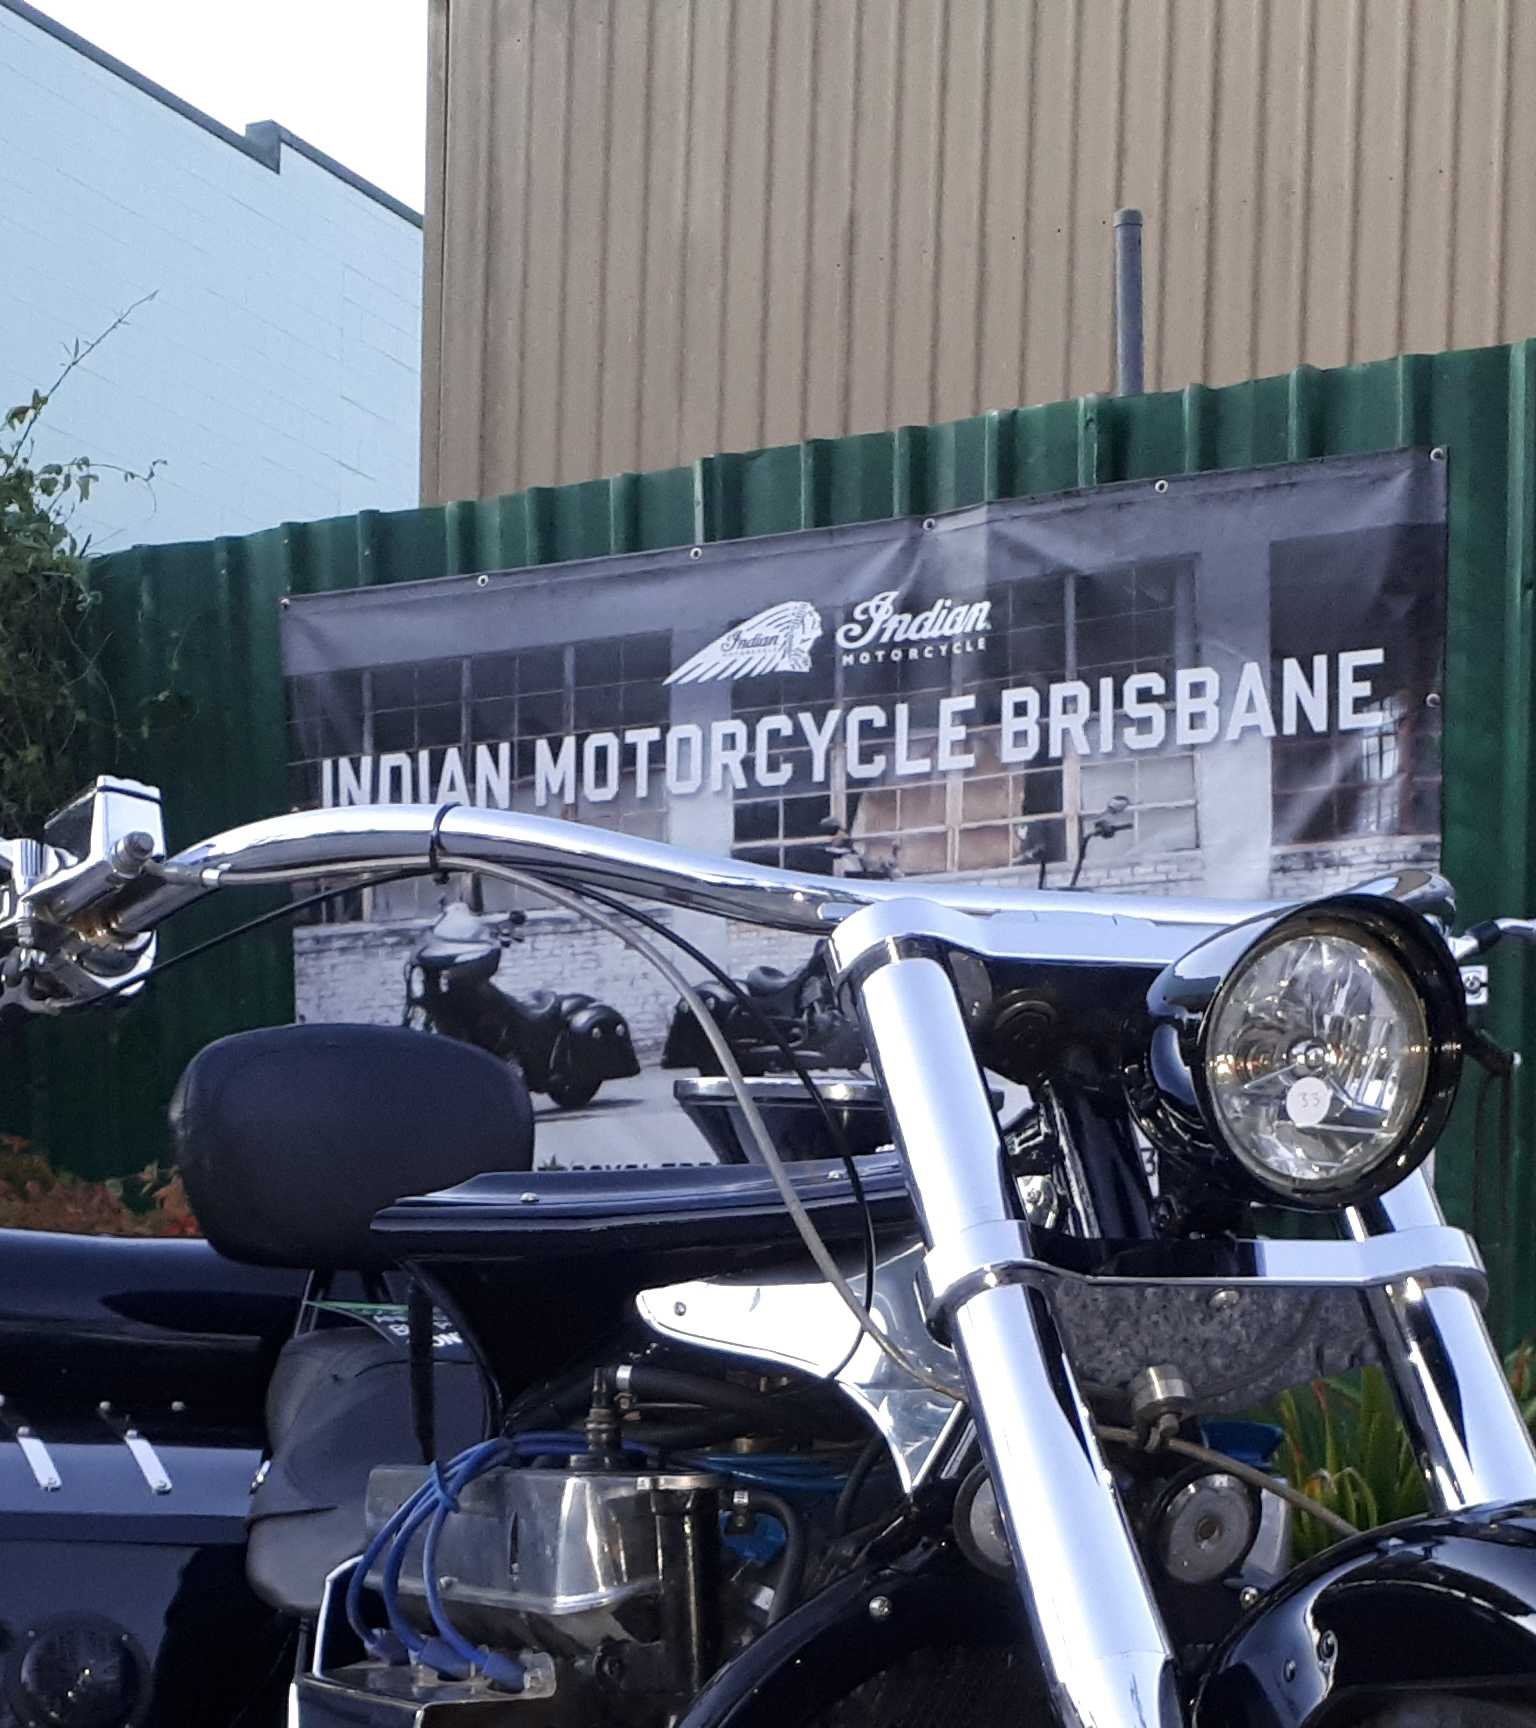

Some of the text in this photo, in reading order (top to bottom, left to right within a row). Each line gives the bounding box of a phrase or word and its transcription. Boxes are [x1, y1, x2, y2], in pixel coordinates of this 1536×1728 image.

[835, 591, 992, 649] Indian
[841, 637, 987, 666] MOTORCYCLE
[322, 648, 1384, 809] INDIAN MOTORCYCLE BRISBANE
